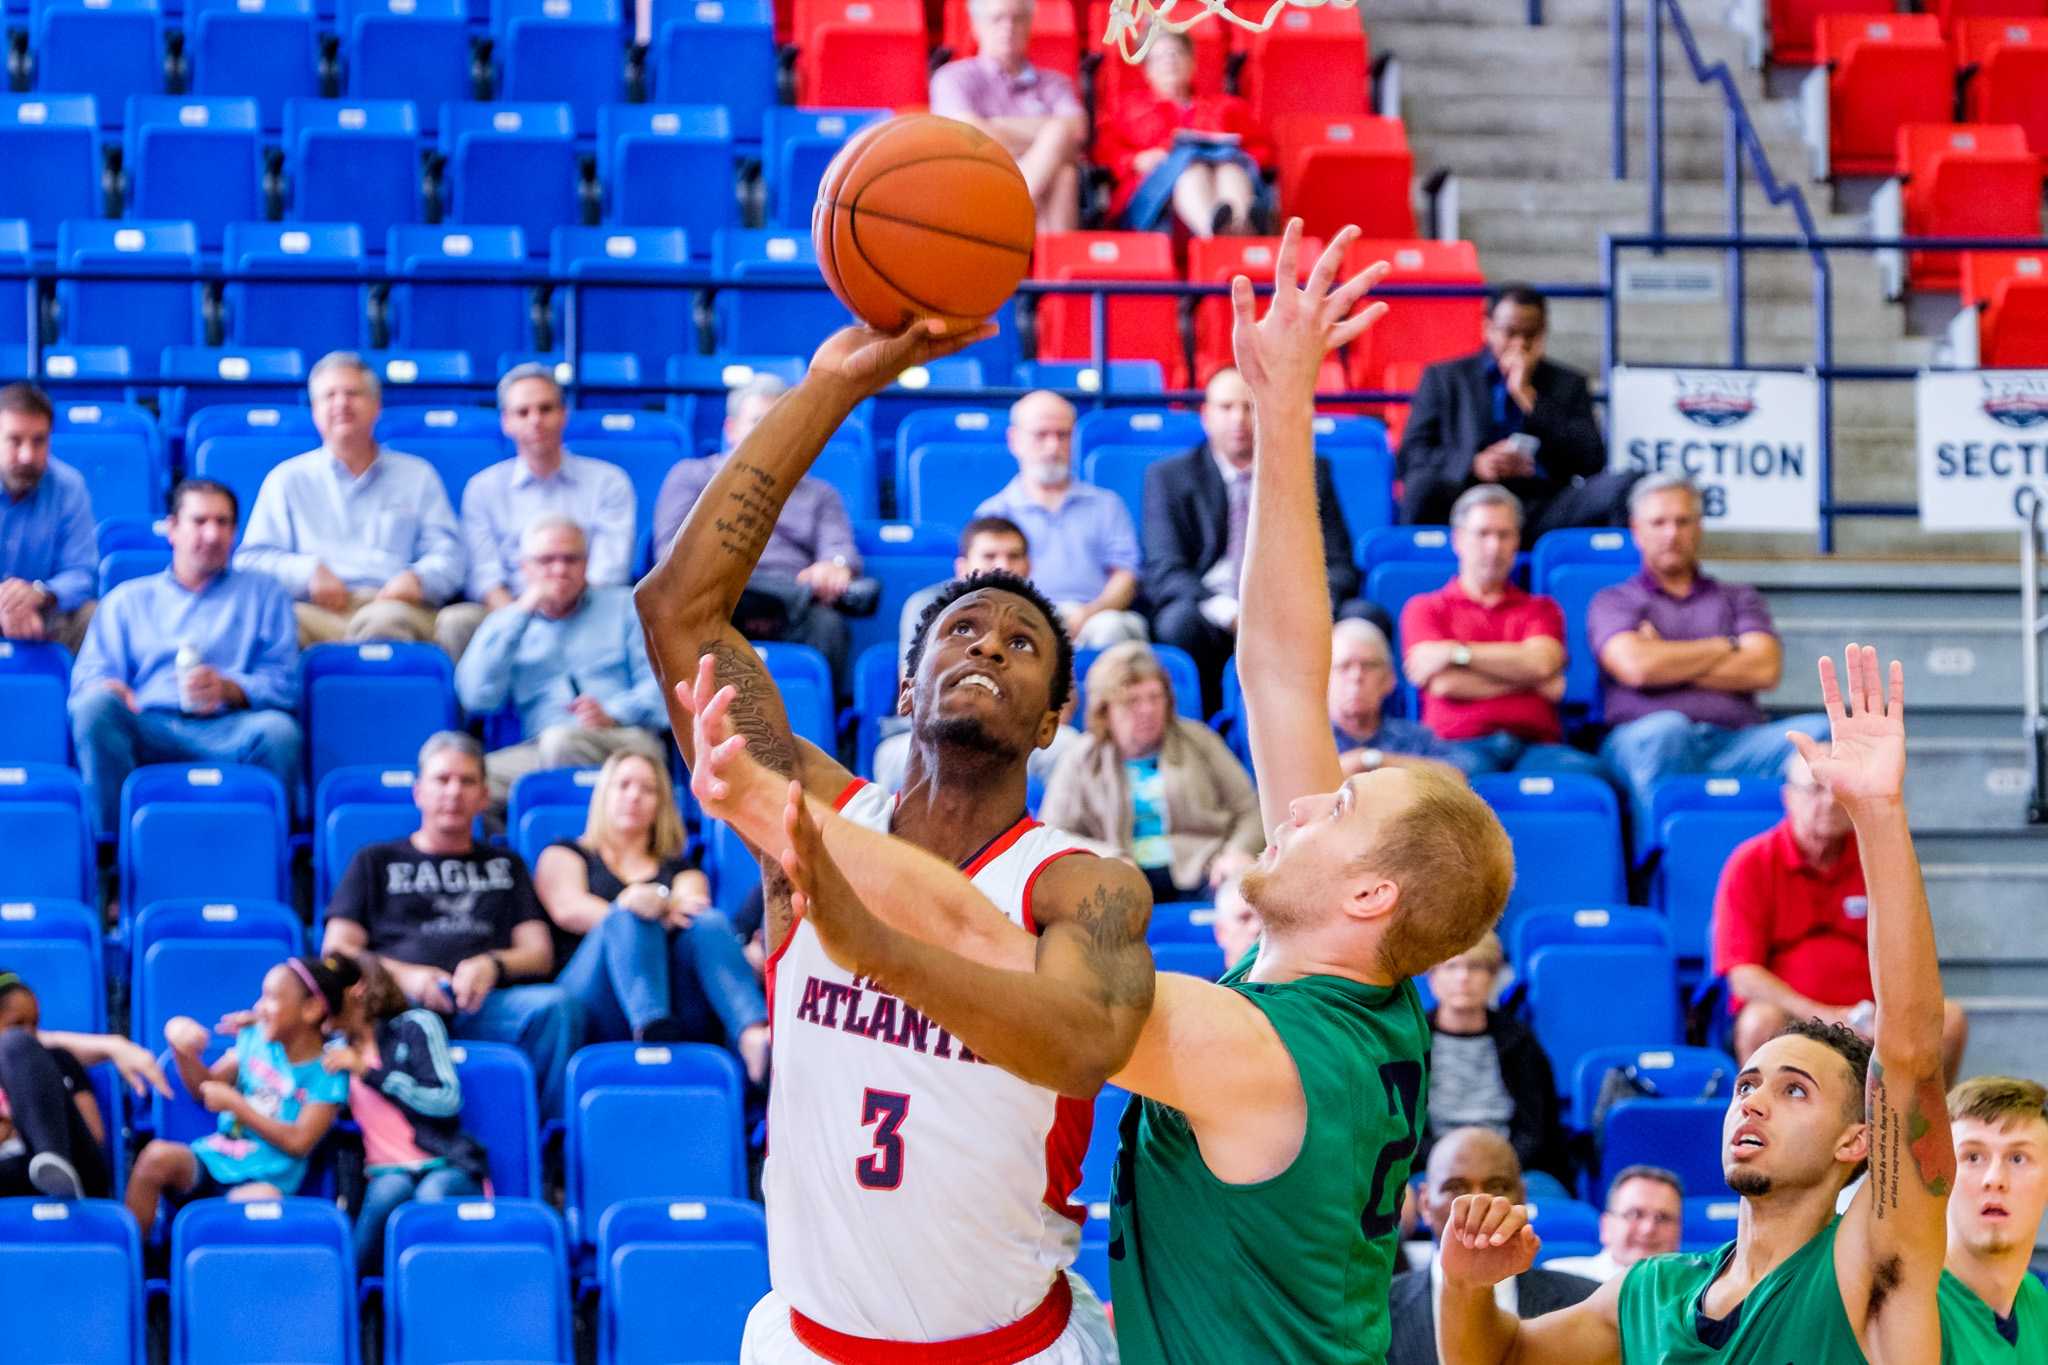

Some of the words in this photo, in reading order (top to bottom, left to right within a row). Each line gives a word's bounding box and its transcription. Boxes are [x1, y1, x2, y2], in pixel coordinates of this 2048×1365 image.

[1629, 439, 1804, 477] SECTION
[386, 856, 515, 895] EAGLE
[796, 975, 990, 1064] ATLANT
[855, 1086, 911, 1191] 3
